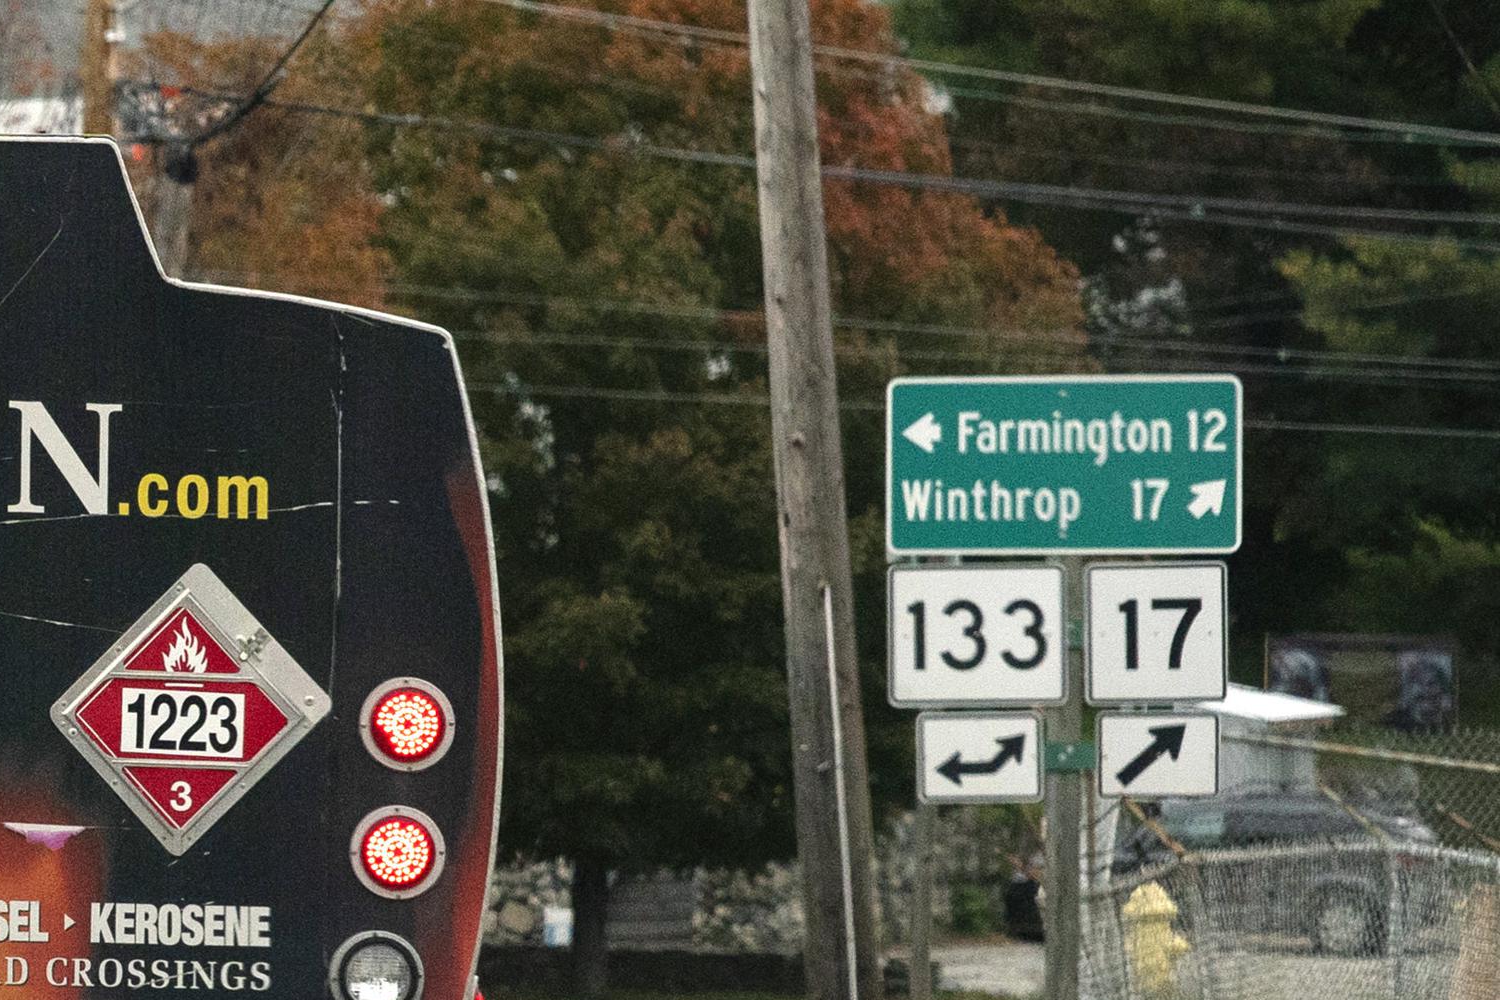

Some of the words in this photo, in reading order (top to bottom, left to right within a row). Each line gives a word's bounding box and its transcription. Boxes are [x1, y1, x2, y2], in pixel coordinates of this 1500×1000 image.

[957, 409, 1172, 466] Farmington
[1187, 407, 1228, 453] 12
[901, 477, 1082, 537] Winthrop
[1130, 477, 1170, 522] 17
[906, 599, 1048, 671] 133
[1118, 597, 1203, 671] 17
[126, 692, 239, 753] 1223
[169, 780, 193, 813] 3
[90, 901, 272, 948] KEROSENE
[45, 955, 272, 992] CROSSINGS
